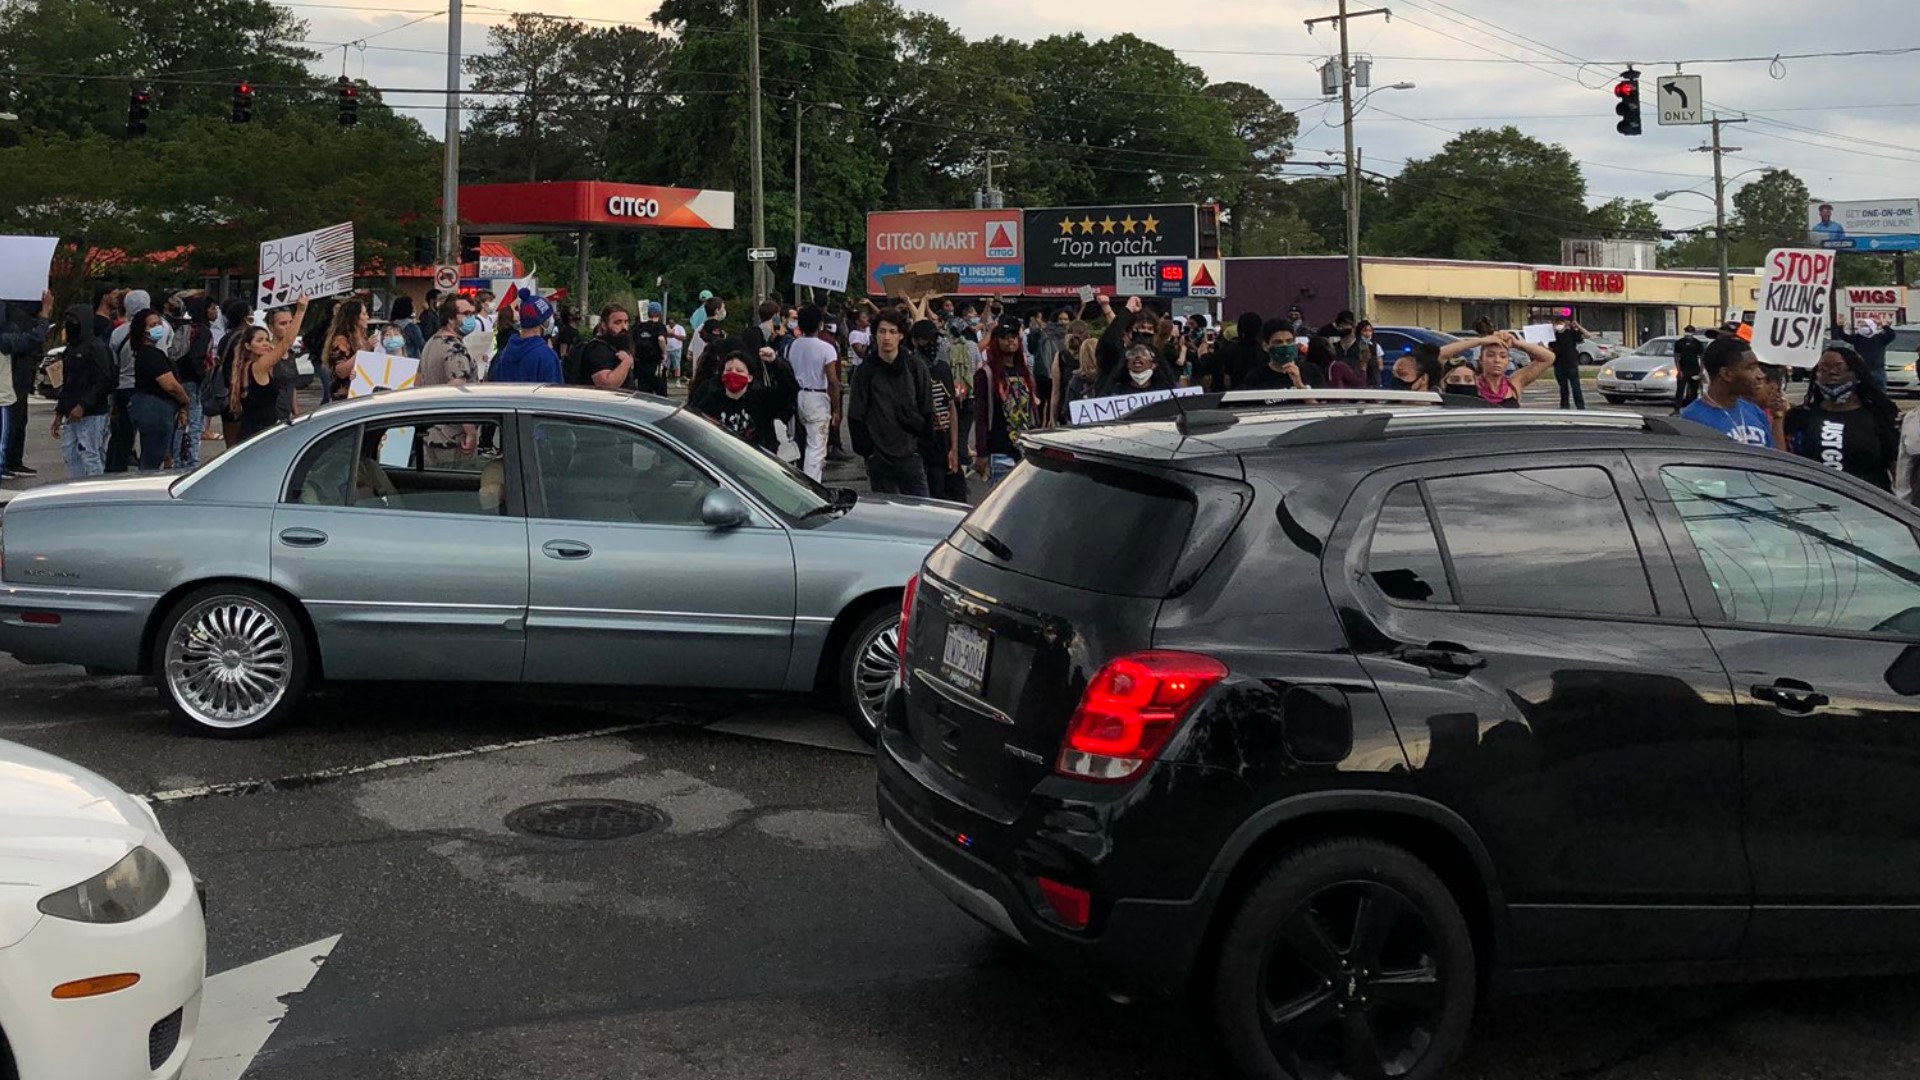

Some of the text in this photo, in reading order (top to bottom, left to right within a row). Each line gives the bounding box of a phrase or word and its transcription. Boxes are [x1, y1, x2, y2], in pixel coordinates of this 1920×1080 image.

[1664, 111, 1696, 121] ONLY
[608, 195, 660, 218] CITGO
[1862, 207, 1913, 218] ONE-ON-ONE
[876, 231, 979, 251] CITGO MART
[260, 237, 316, 275] Black
[987, 249, 1015, 257] CITGO
[799, 261, 811, 270] NOT
[968, 266, 1006, 277] INSIDE
[1122, 261, 1157, 278] rutte
[1770, 251, 1833, 285] STOP!
[279, 264, 325, 289] Lives
[1536, 270, 1625, 294] BEAUTY TO GO
[288, 279, 337, 303] Matter
[1191, 287, 1217, 295] CITGO
[1765, 282, 1827, 315] KILLING
[1848, 289, 1897, 304] WIGS
[1770, 316, 1823, 350] US!!
[1820, 420, 1846, 449] JUST
